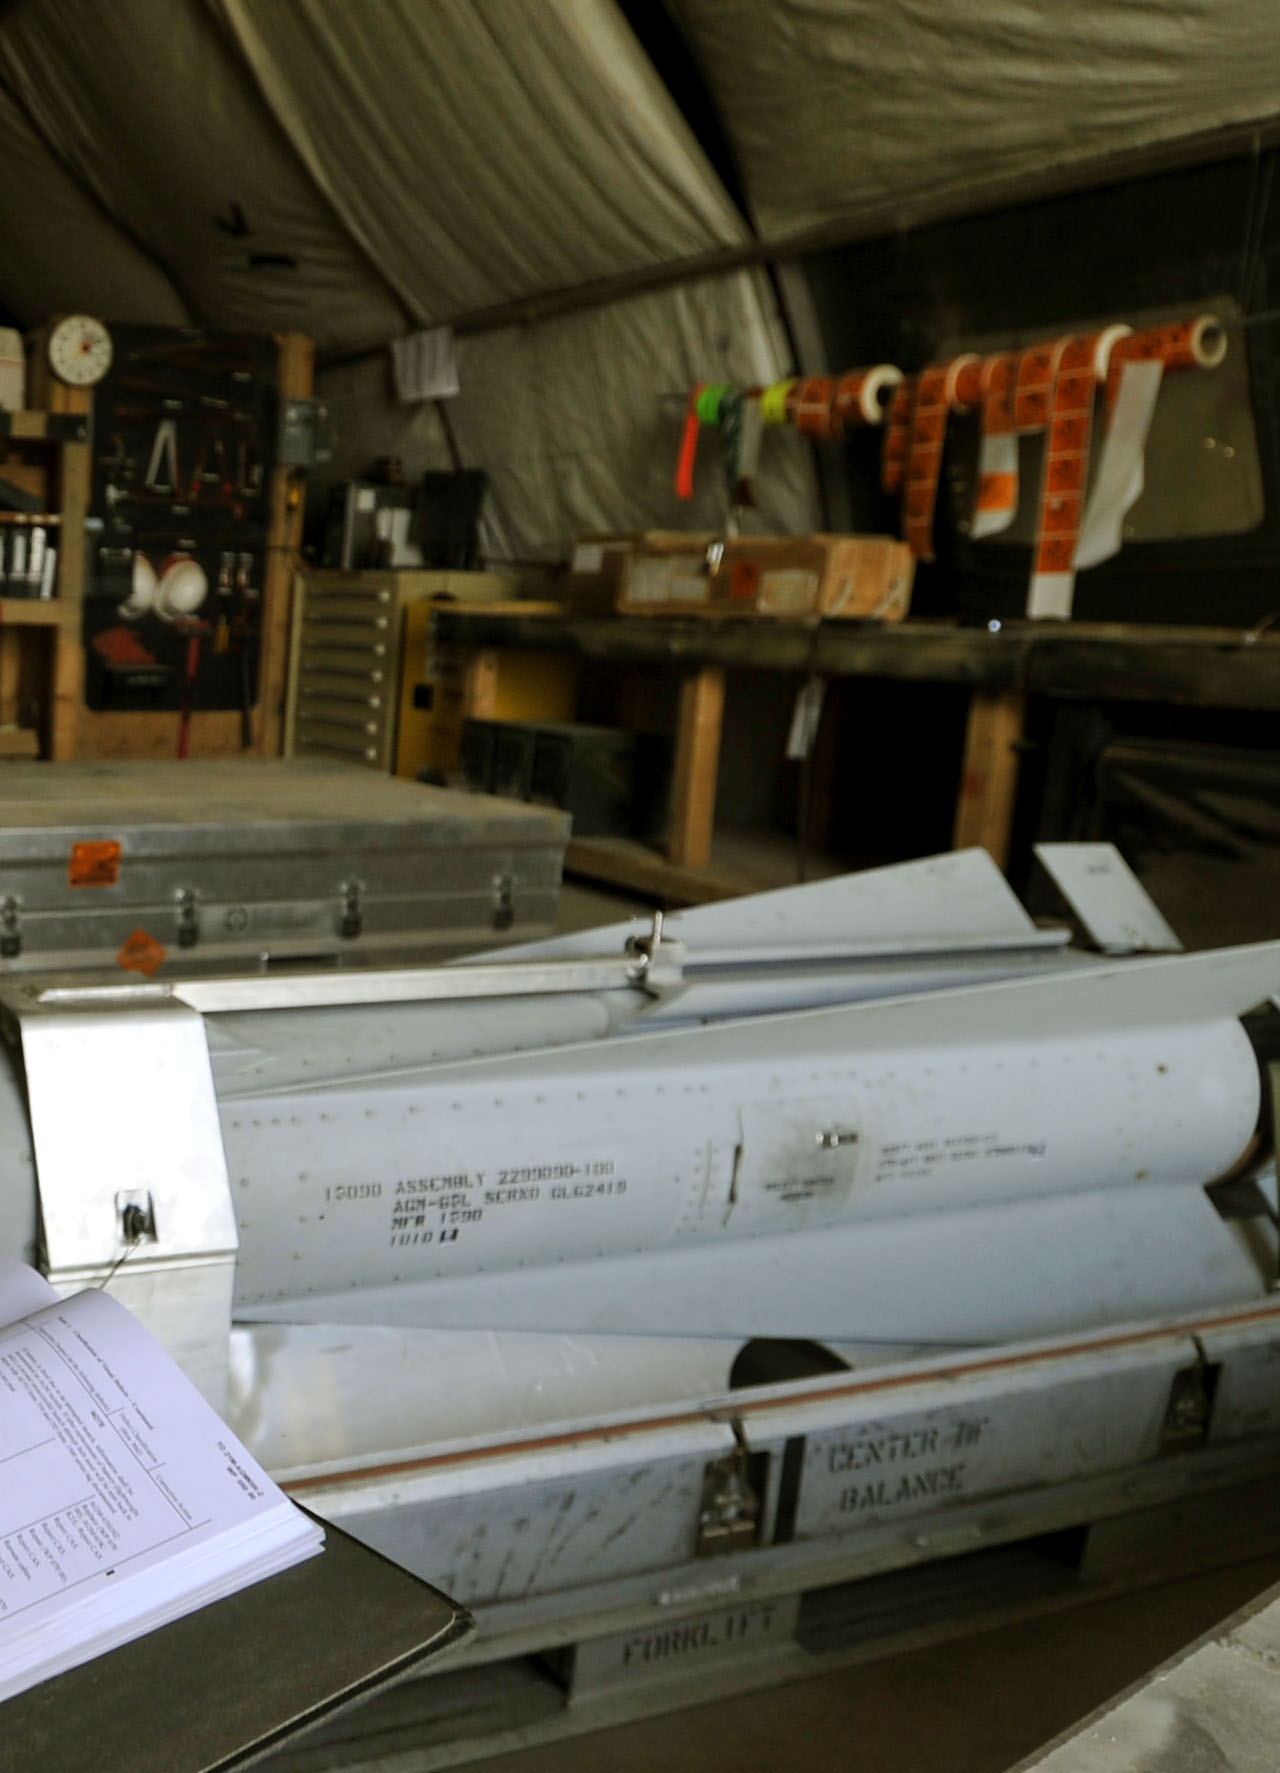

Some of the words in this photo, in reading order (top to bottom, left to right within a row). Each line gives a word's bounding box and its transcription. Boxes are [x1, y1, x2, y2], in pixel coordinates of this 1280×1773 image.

[394, 1173, 486, 1196] ASSEMBLY
[840, 1463, 965, 1513] BALANCE
[624, 1606, 778, 1665] FORKLIFT
